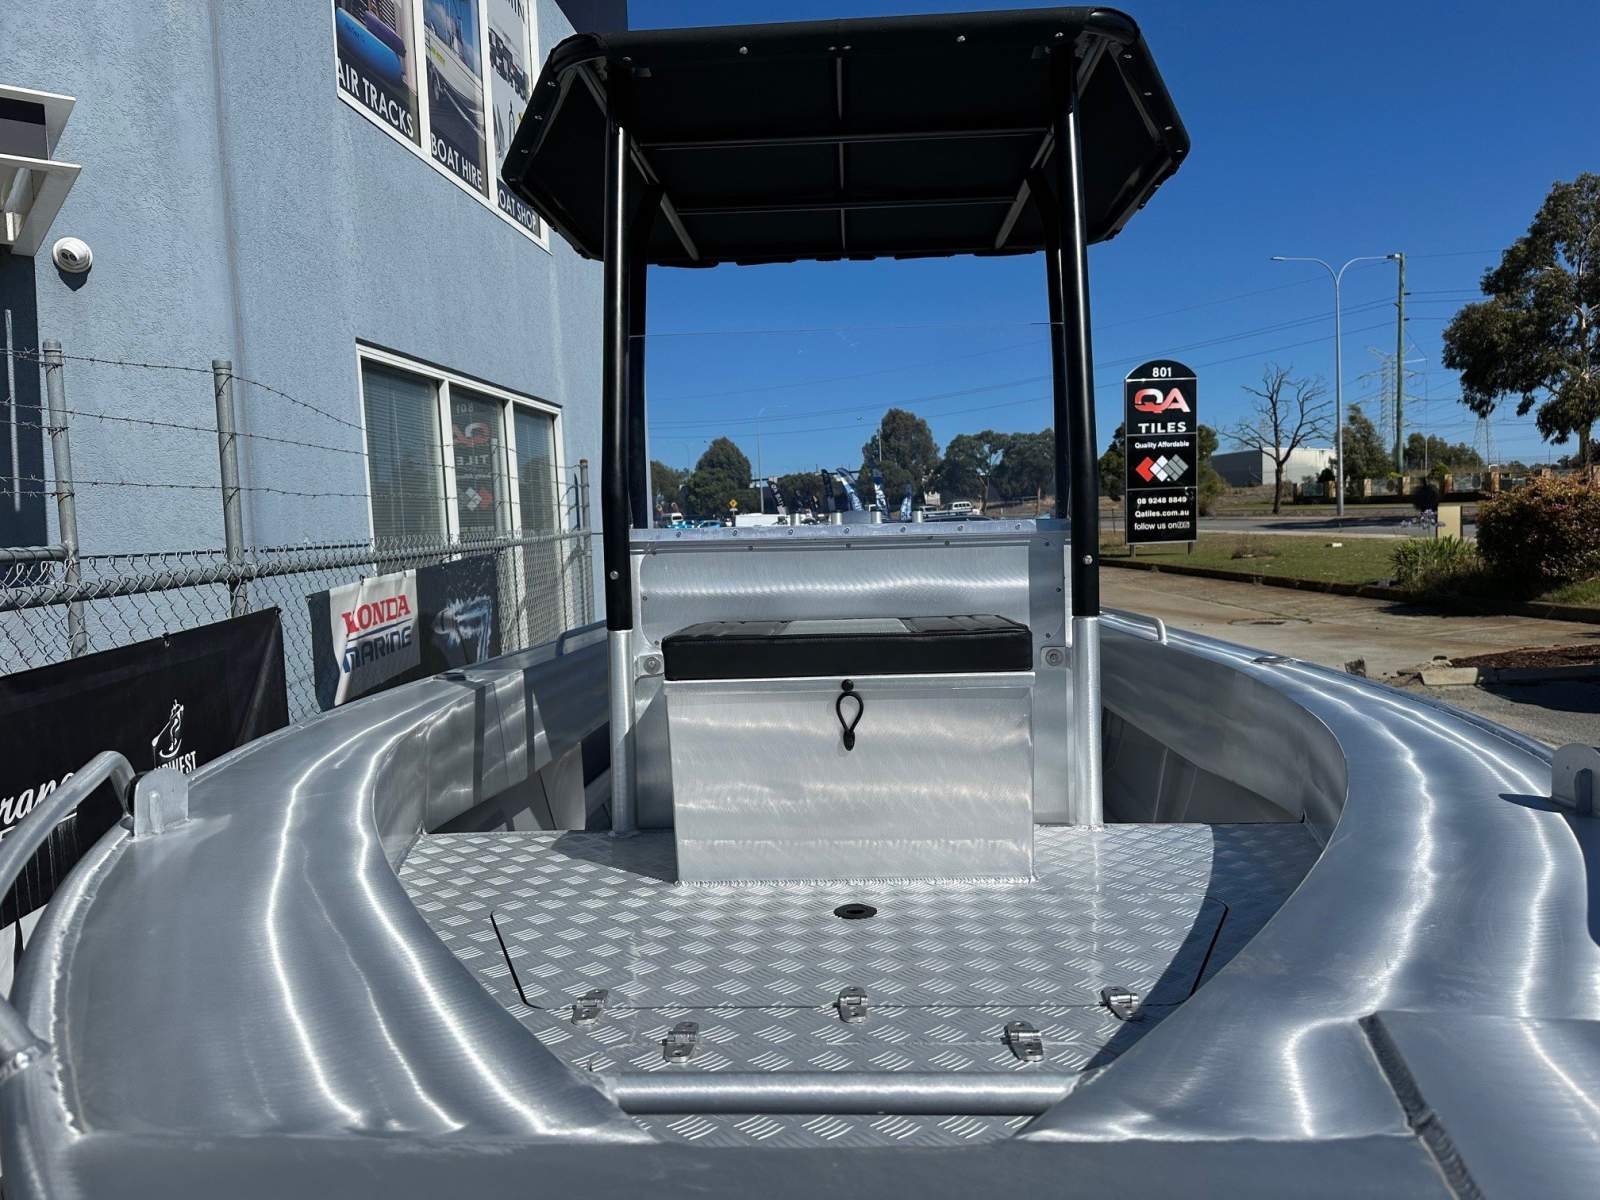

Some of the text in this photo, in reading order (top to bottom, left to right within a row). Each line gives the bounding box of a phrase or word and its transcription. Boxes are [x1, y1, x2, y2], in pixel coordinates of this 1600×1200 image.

[337, 57, 415, 138] AIR TRACKS
[430, 132, 483, 191] BOAT HIRE
[497, 189, 537, 231] OAT SHOP
[1152, 366, 1172, 378] 801
[1134, 388, 1191, 414] QA
[1138, 421, 1187, 434] TILES
[1134, 440, 1190, 450] Quality Affordable
[1134, 522, 1156, 531] follow
[1156, 522, 1167, 530] us
